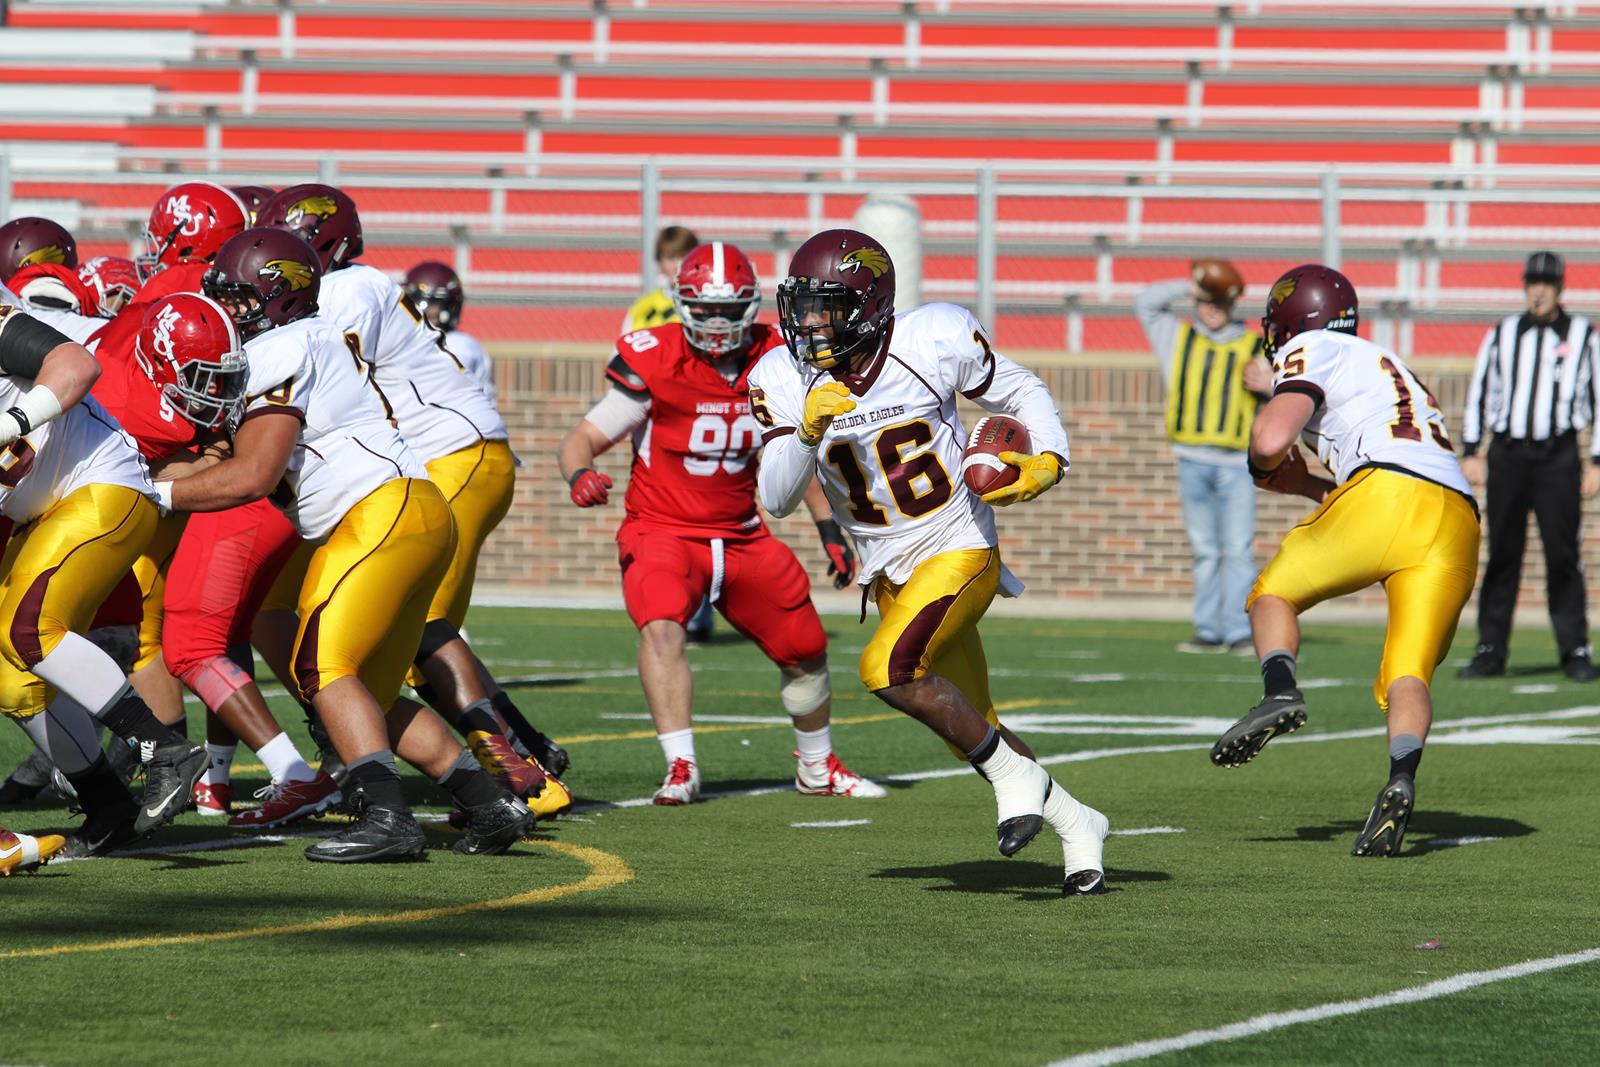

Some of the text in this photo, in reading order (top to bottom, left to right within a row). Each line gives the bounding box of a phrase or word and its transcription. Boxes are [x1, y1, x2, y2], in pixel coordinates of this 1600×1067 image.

[683, 414, 764, 477] 90
[832, 405, 905, 431] GOLDEN EAGLES
[825, 418, 955, 527] 16
